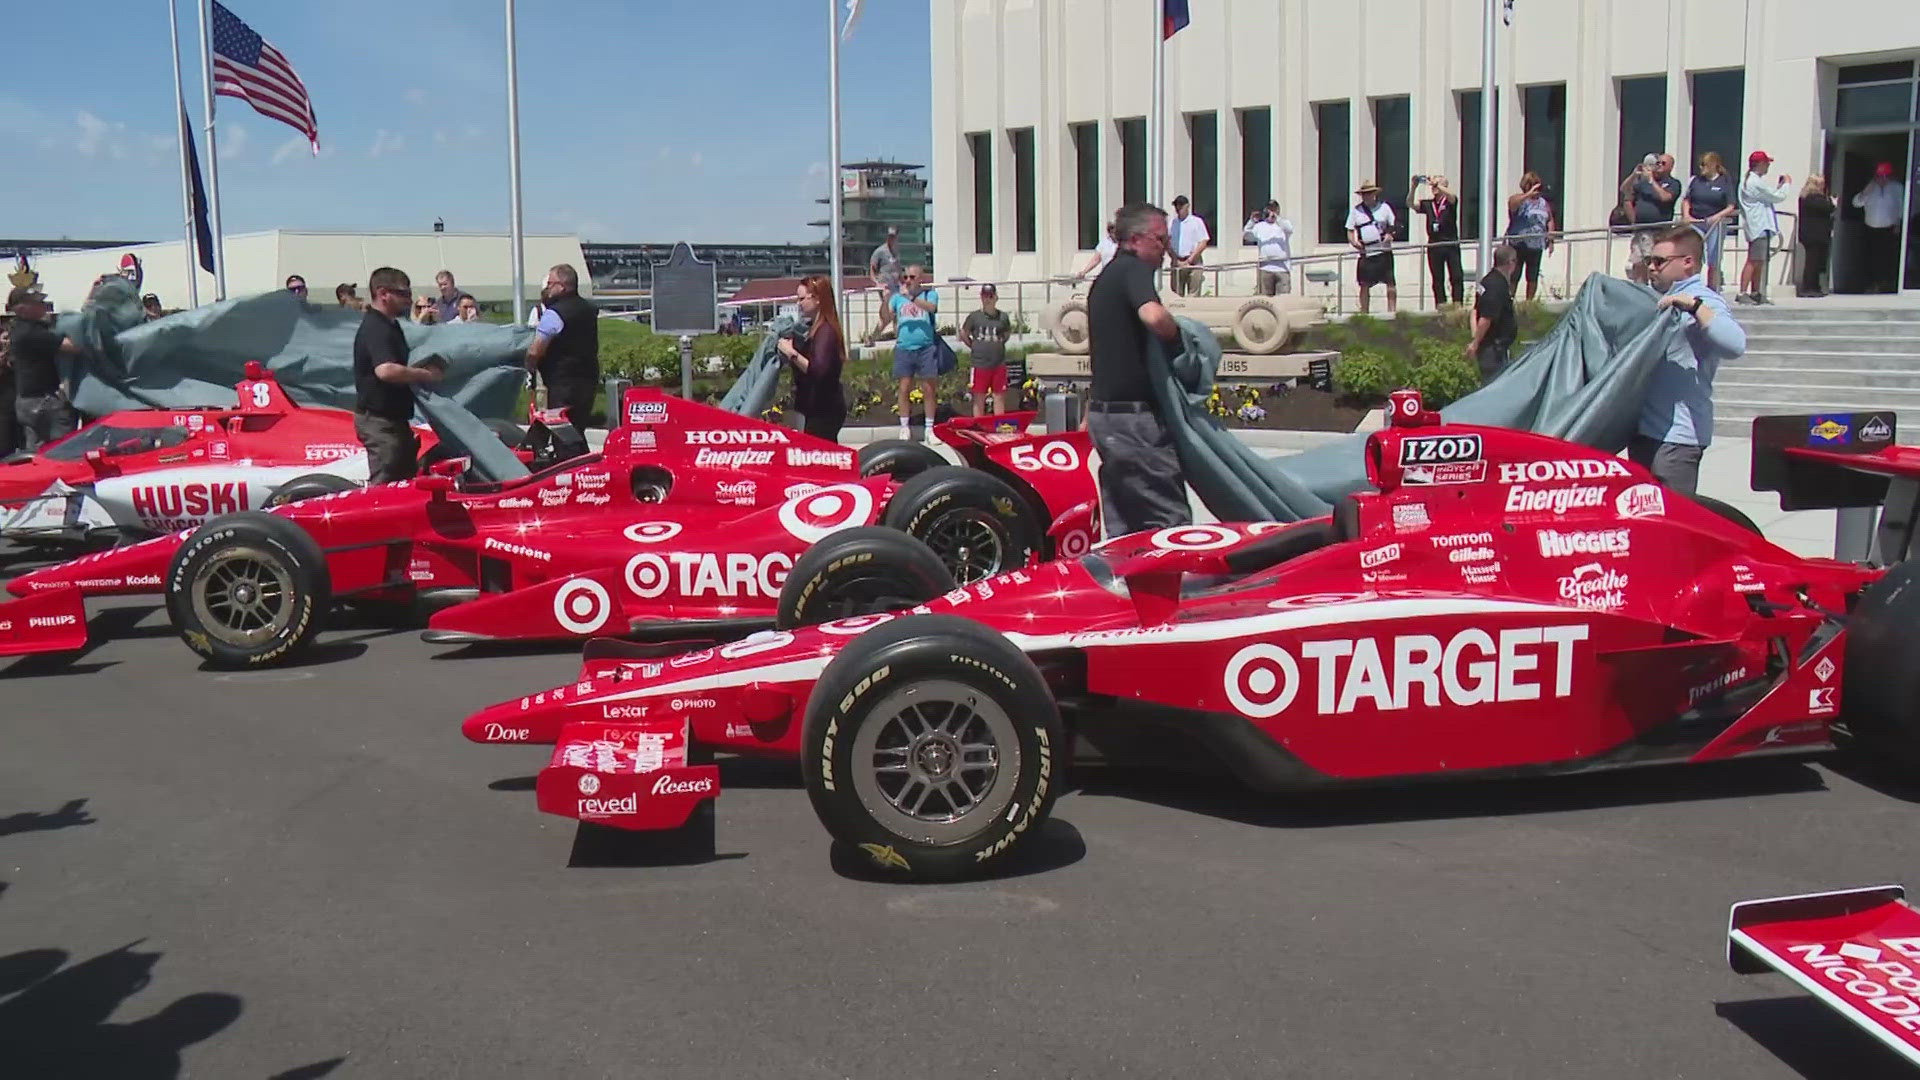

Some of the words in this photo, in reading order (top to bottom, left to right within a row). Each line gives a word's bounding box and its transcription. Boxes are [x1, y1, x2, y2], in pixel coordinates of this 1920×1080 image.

[1222, 360, 1249, 373] 1965
[252, 382, 271, 409] 8
[684, 430, 790, 445] HONDA
[695, 448, 775, 468] Energizer
[787, 448, 853, 466] HUGGIES
[1406, 439, 1476, 461] IZOD
[1499, 459, 1632, 483] HONDA
[716, 481, 757, 494] Suave
[132, 481, 249, 518] HUSKI
[1505, 483, 1608, 515] Energizer
[485, 537, 552, 561] Firestone
[1537, 527, 1631, 558] HUGGIES
[173, 529, 235, 592] Firestone
[1363, 546, 1398, 567] GLAD
[1449, 547, 1495, 562] Gillette
[670, 552, 802, 597] TARG
[1461, 562, 1501, 576] Maxwell
[126, 575, 161, 586] Kodak
[1556, 568, 1629, 599] Breathe
[29, 614, 76, 628] PHILIPS
[950, 655, 1017, 690] Firestone
[1302, 624, 1589, 715] TARGET
[1689, 666, 1746, 706] Firestone
[603, 705, 649, 718] Lexar
[684, 699, 716, 709] PHOTO
[485, 723, 530, 740] Dove
[822, 716, 839, 792] INDY
[840, 665, 890, 714] 500
[651, 774, 713, 796] Reese's
[975, 727, 1050, 862] FIREHAWK
[578, 792, 638, 813] reveal
